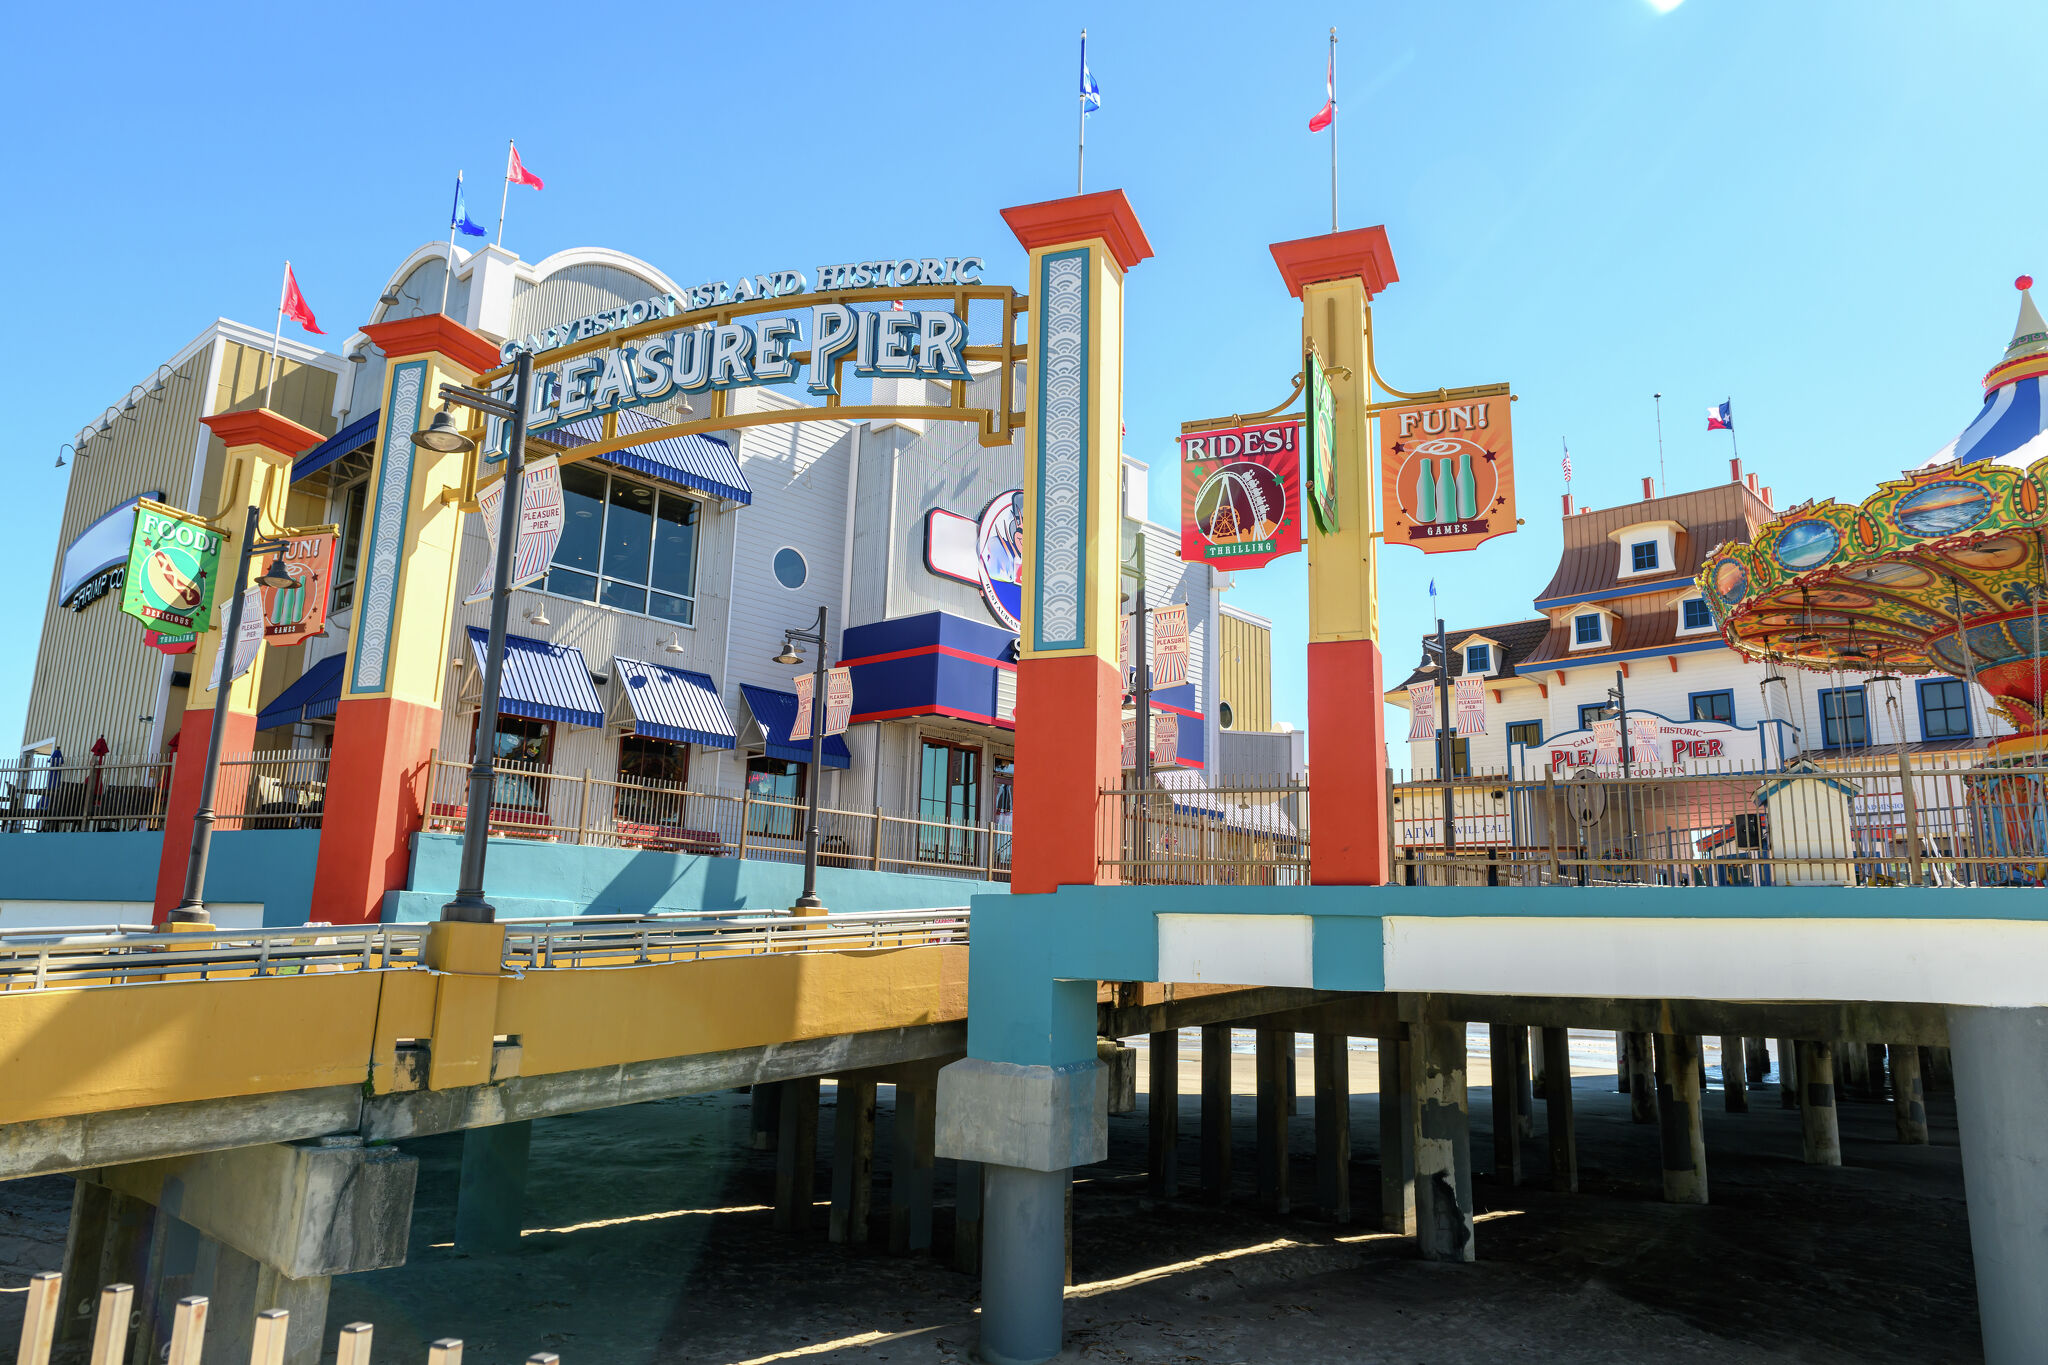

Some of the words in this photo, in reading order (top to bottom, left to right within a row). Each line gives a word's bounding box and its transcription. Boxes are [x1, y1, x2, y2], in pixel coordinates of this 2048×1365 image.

[500, 292, 676, 363] GALVESTON
[684, 269, 806, 312] ISLAND
[814, 256, 985, 292] HISTORIC
[484, 316, 803, 464] PLEASURE
[807, 303, 975, 396] PIER
[1399, 403, 1489, 438] FUN!
[1185, 427, 1295, 461] RIDES!
[523, 507, 560, 521] PLEASURE
[532, 520, 549, 530] PIER
[1427, 523, 1469, 536] GAMES
[142, 512, 219, 555] FOOD!
[1209, 542, 1272, 556] THRILLING
[72, 574, 107, 612] SHRIMP
[985, 583, 1021, 630] RESTAURAN
[145, 607, 190, 626] DELICIOUS
[274, 625, 296, 634] GAMES
[160, 633, 194, 644] THRILLING
[1157, 637, 1186, 646] PLEASURE
[1659, 726, 1703, 737] HISTORIC
[1671, 738, 1725, 763] PIER
[1663, 766, 1685, 775] FUN
[1404, 827, 1436, 839] ATM
[1454, 826, 1480, 835] WILL
[1483, 824, 1511, 834] CALL
